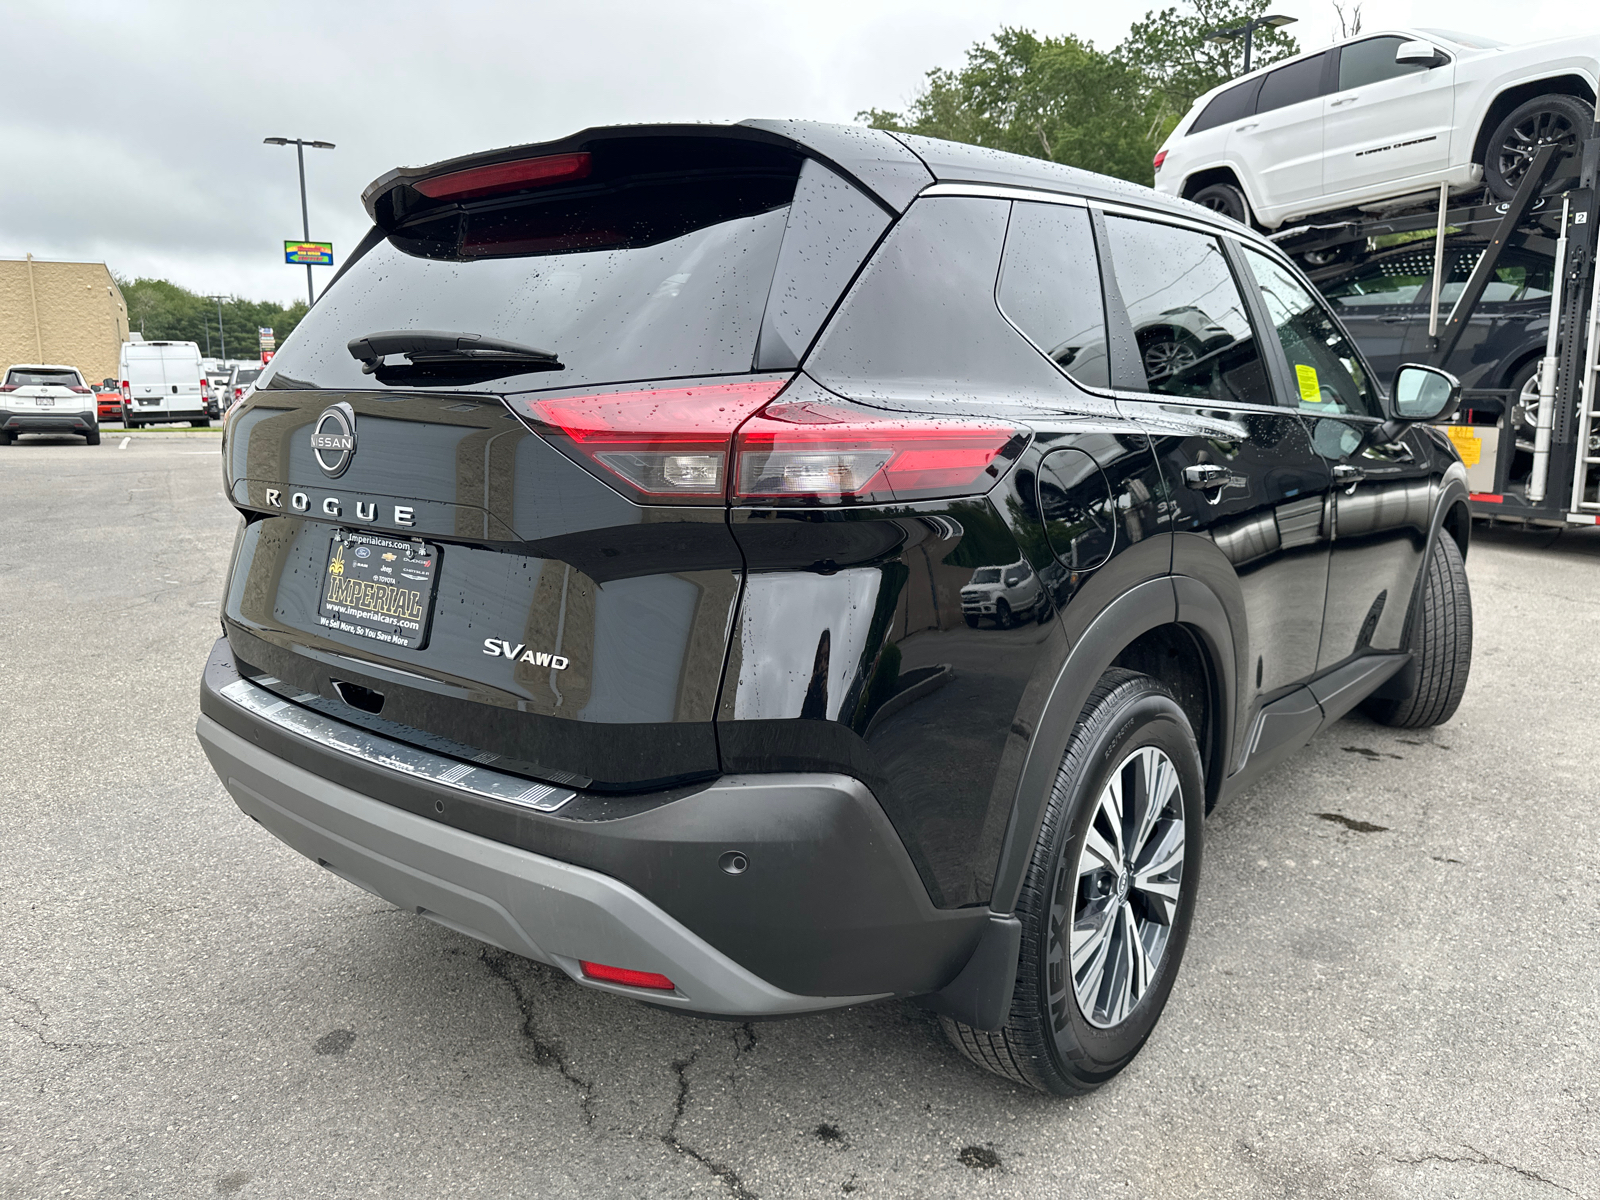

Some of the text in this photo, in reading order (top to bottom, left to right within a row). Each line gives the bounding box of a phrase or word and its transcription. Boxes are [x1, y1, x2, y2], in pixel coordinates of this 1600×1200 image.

[1578, 213, 1585, 222] 2
[311, 436, 351, 449] NISSAN
[266, 488, 416, 527] ROGUE
[347, 533, 411, 551] Imperialcars.com
[378, 575, 396, 585] TOYOTA
[380, 565, 393, 575] Jeep
[327, 575, 423, 621] IMPERIAL
[326, 602, 420, 630] www.imperialcars.com
[320, 616, 330, 627] We
[329, 619, 340, 629] Sell
[356, 626, 365, 636] So
[365, 628, 377, 639] You
[377, 631, 392, 643] Save
[391, 635, 409, 647] More
[482, 638, 569, 671] SV AWD
